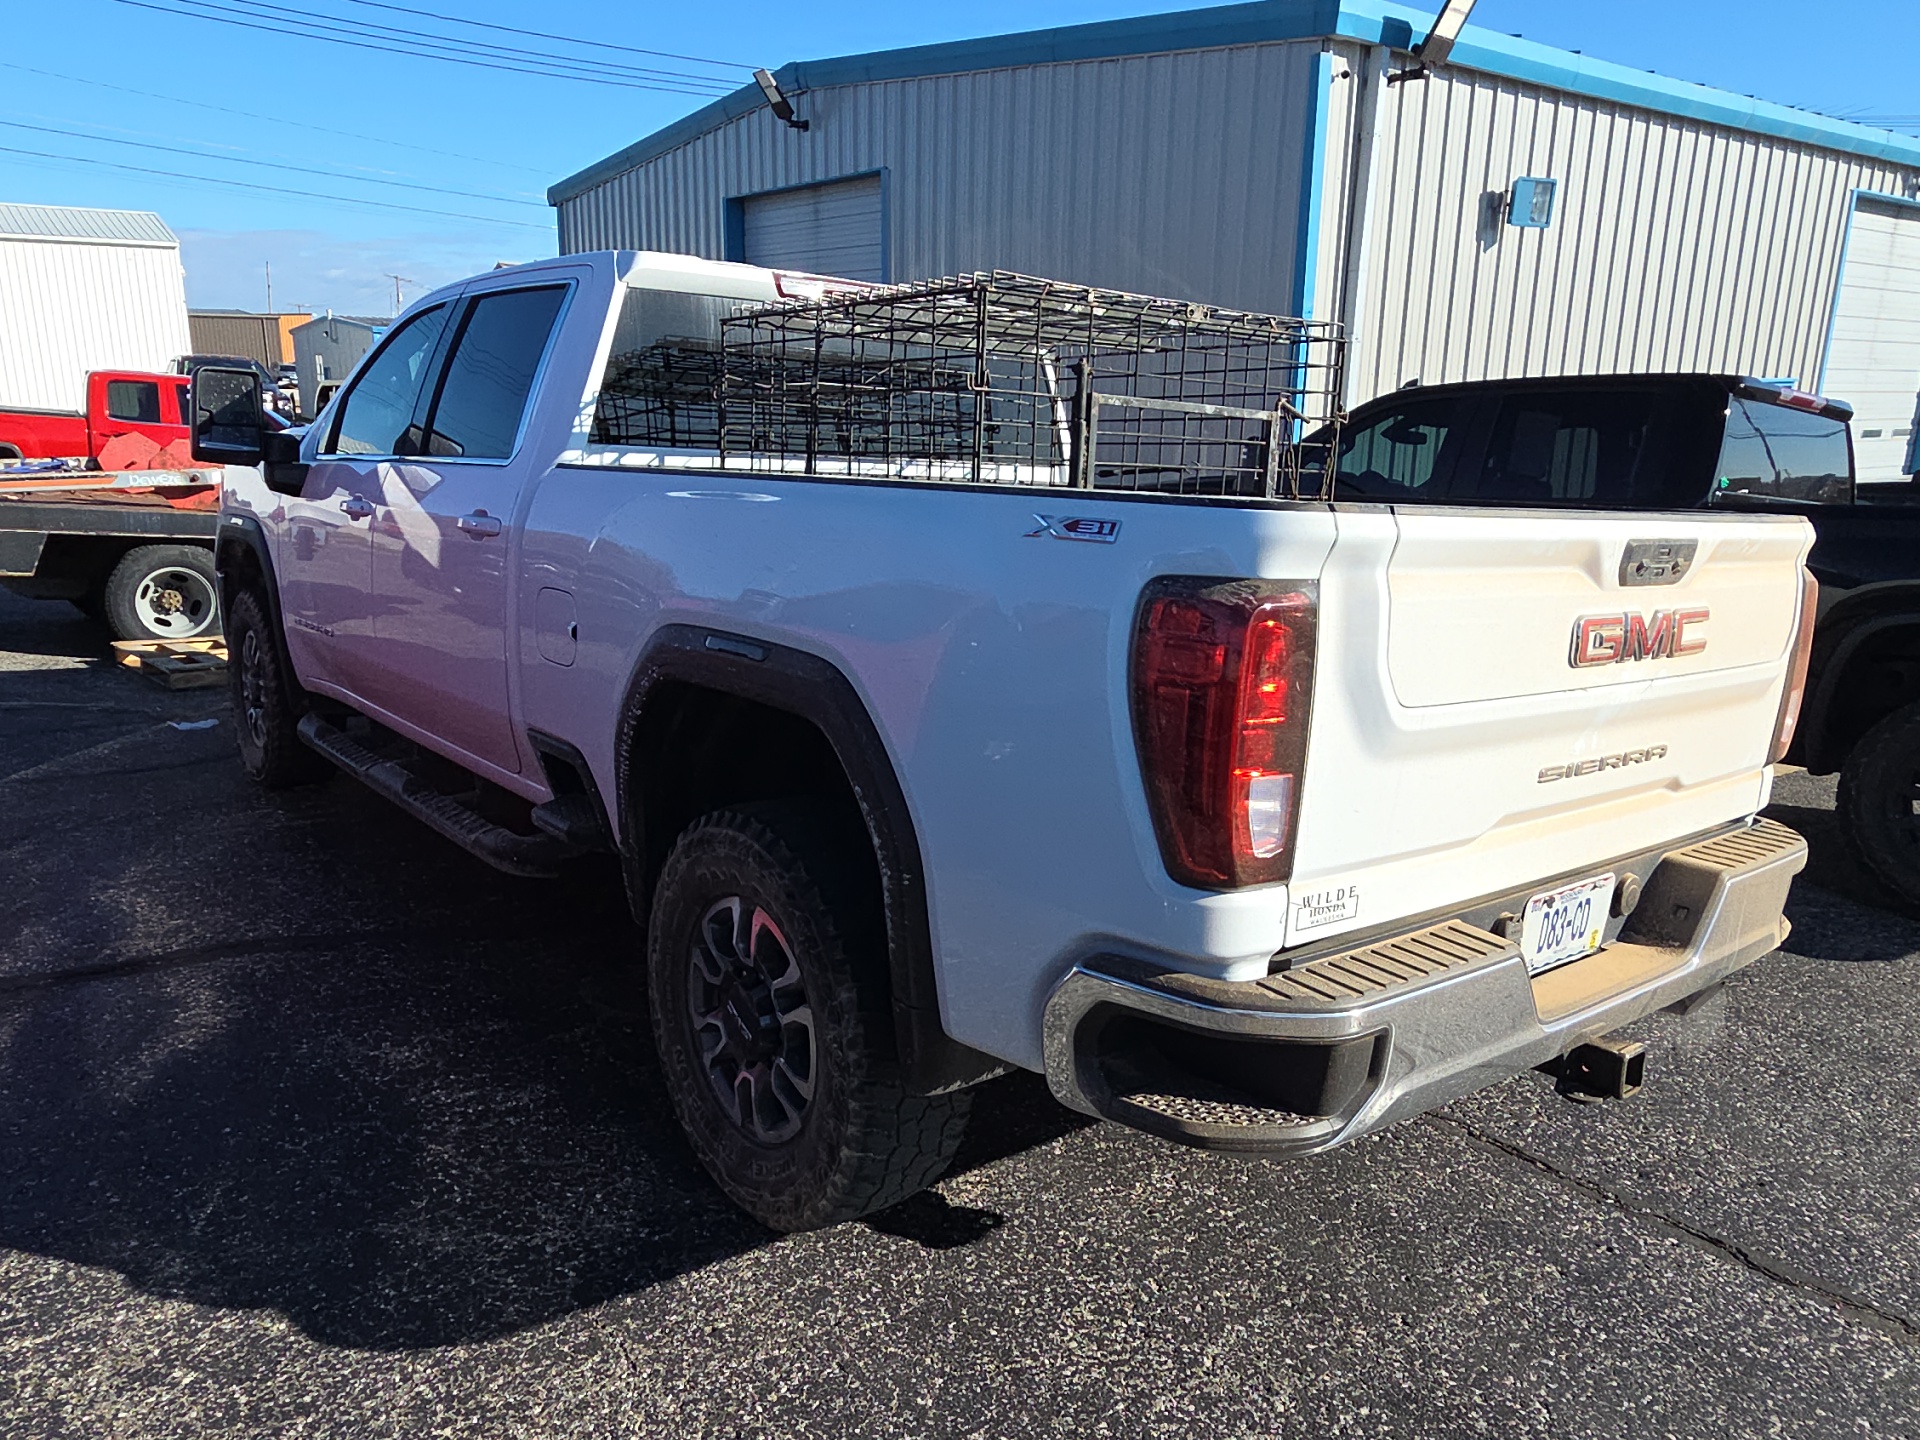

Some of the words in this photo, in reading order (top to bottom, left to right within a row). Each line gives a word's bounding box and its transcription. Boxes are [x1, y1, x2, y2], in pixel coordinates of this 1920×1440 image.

[1021, 513, 1121, 544] X31
[1568, 606, 1710, 669] GMC
[1537, 744, 1668, 784] SIERRA
[1302, 885, 1357, 909] WILDE
[1309, 902, 1346, 918] HONDA
